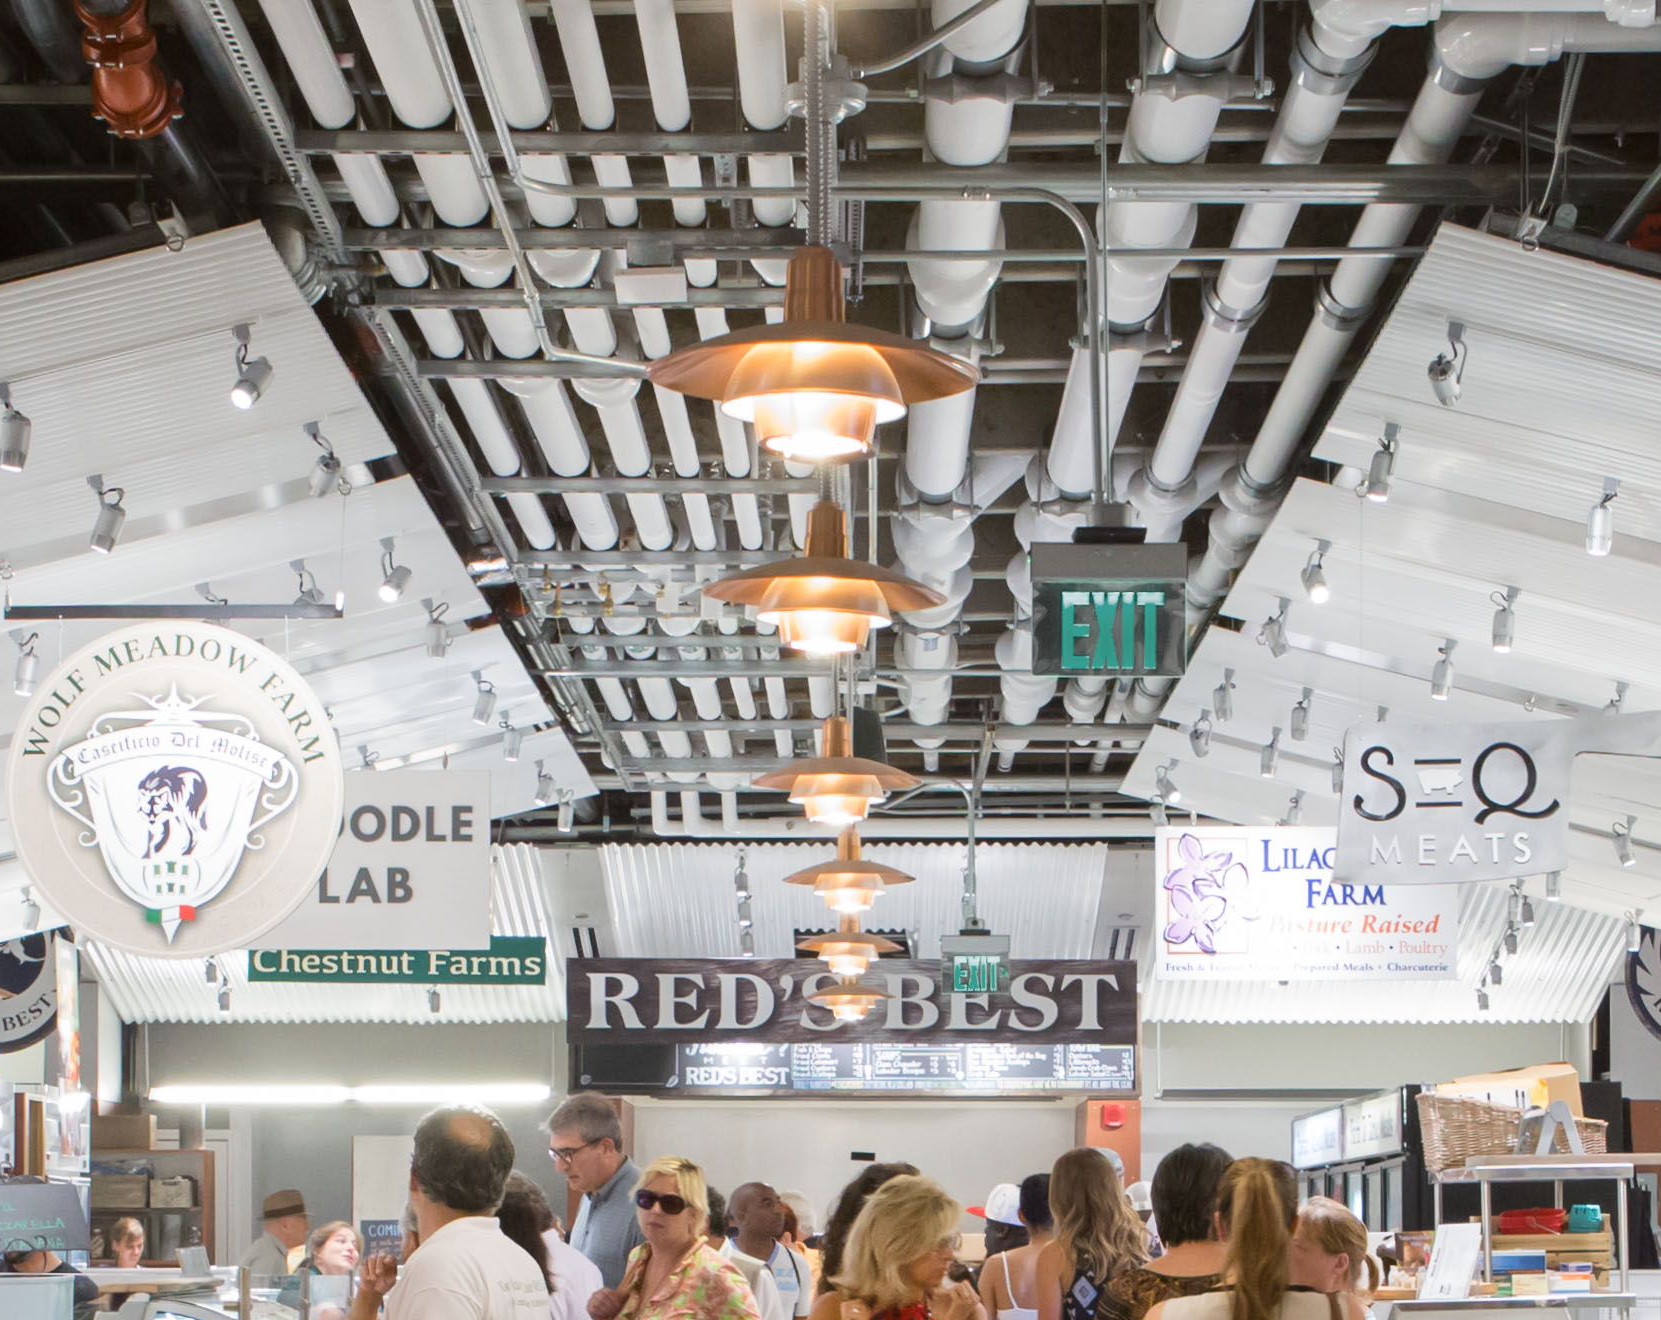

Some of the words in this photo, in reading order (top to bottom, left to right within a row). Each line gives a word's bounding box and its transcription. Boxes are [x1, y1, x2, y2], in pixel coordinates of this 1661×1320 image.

[1061, 591, 1165, 670] EXIT
[22, 668, 86, 757] WOLF
[92, 634, 258, 677] MEADOW
[259, 673, 325, 764] FARM
[338, 805, 473, 843] ODLE
[1370, 832, 1533, 866] MEATS
[319, 867, 413, 904] LAB
[1305, 879, 1387, 908] FARM
[1361, 914, 1441, 934] Raised
[252, 950, 414, 975] Chestnut
[427, 951, 542, 976] Farms
[1343, 963, 1374, 972] Meals
[1386, 962, 1449, 972] Charcuterie
[1345, 941, 1385, 953] Lamb
[1399, 941, 1448, 957] Poultry
[954, 955, 1000, 991] EXIT
[1, 994, 52, 1032] BEST
[585, 972, 844, 1031] RED'S
[882, 972, 1120, 1032] BEST
